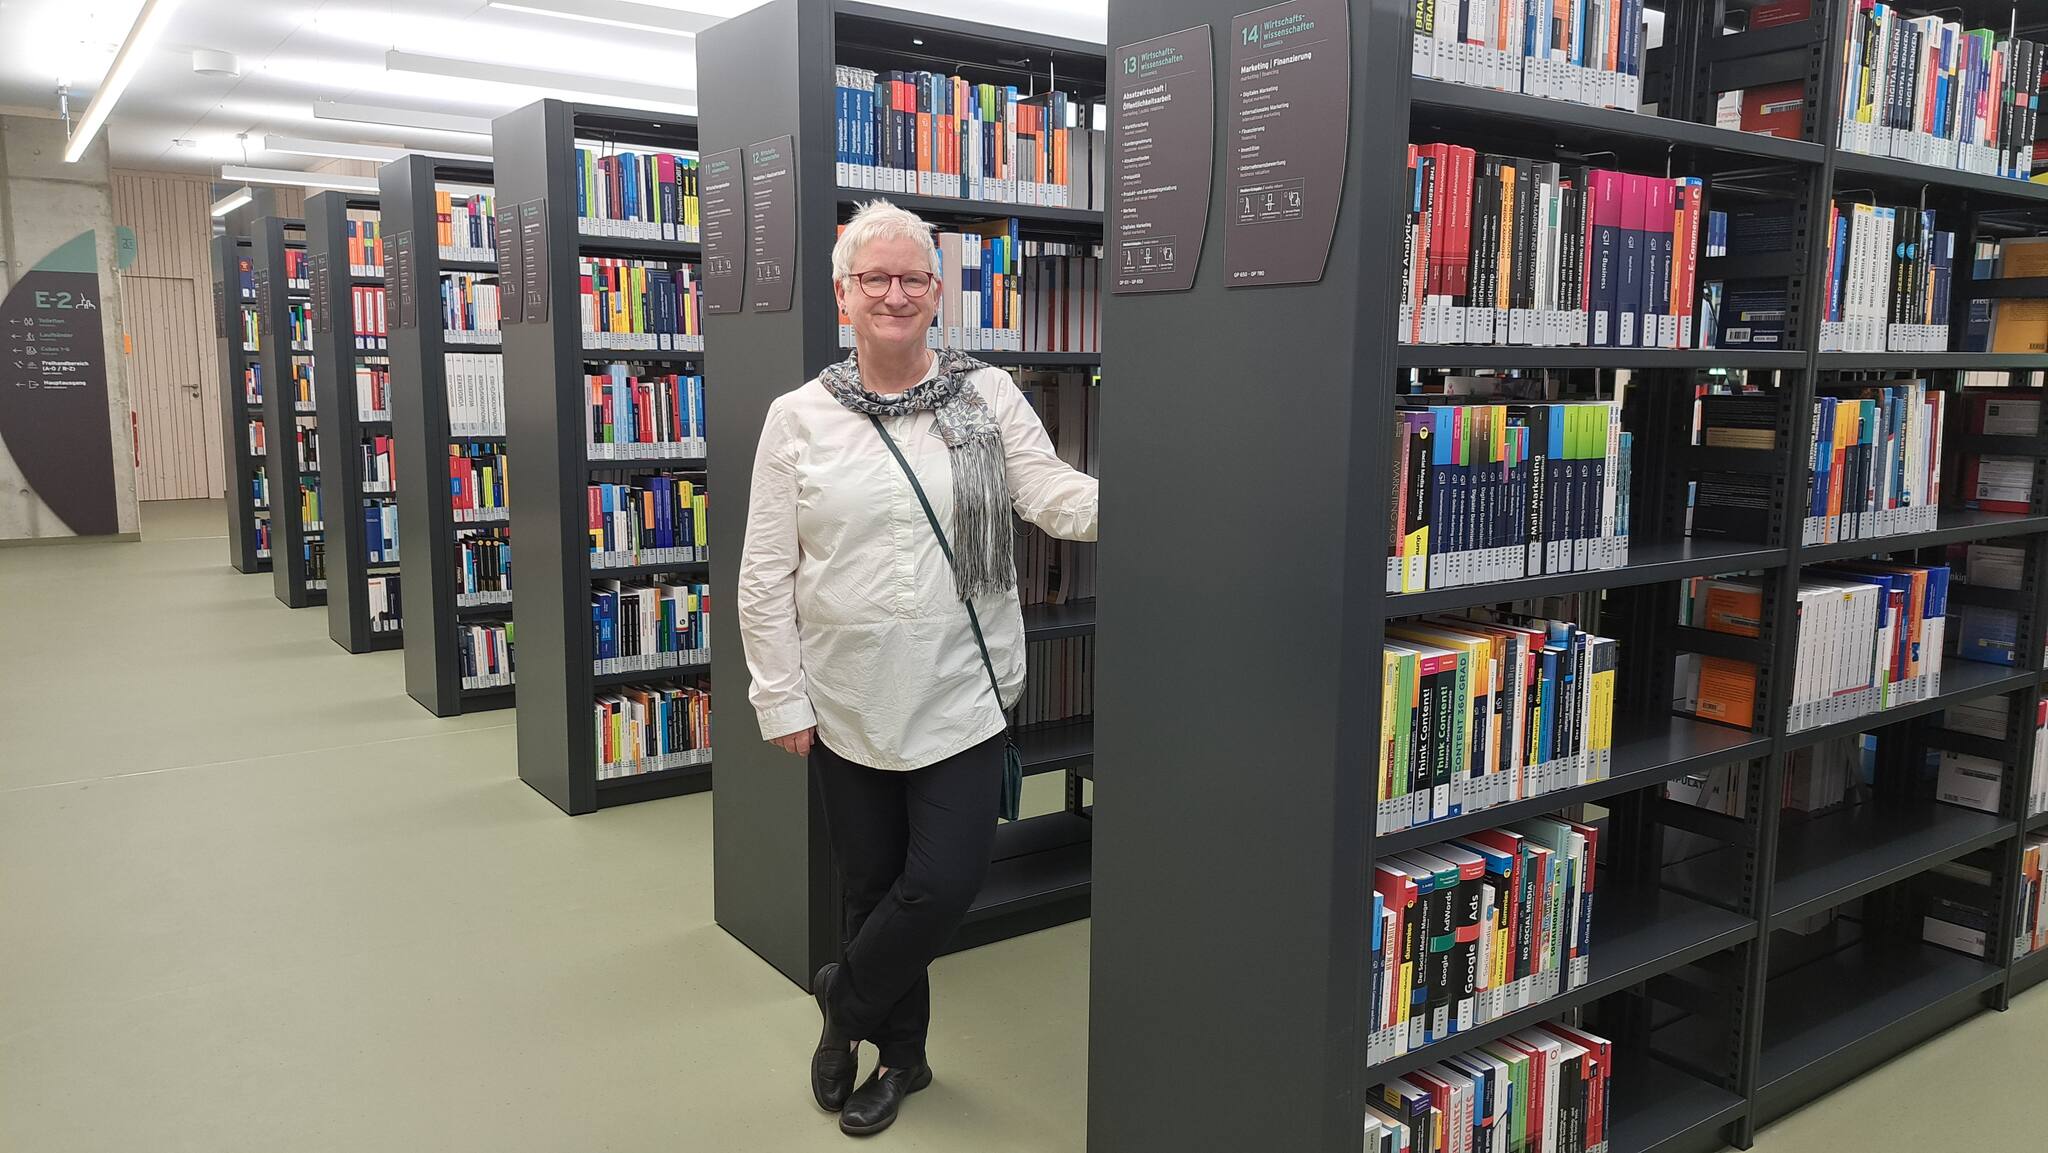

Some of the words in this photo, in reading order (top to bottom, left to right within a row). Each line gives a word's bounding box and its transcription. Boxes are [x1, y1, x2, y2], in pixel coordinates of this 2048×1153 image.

[1241, 24, 1259, 46] 14
[1263, 14, 1305, 30] Wirtschafts-
[1263, 21, 1315, 41] wissenschaften
[1124, 56, 1137, 74] 13
[1141, 47, 1176, 62] Wirtschafts-
[1141, 54, 1183, 70] wissenschaften
[1240, 62, 1269, 75] Marketing
[1273, 52, 1312, 67] Finanzierung
[1888, 67, 1896, 104] DIGITAL
[1892, 28, 1901, 66] DENKEN
[1897, 69, 1905, 106] DIGITAL
[1901, 31, 1909, 67] DENKEN
[1905, 71, 1913, 107] DIGITAL
[1909, 32, 1918, 69] DENKEN
[1404, 213, 1412, 263] Analytics
[1531, 204, 1539, 250] MARKETING
[1687, 209, 1698, 271] E-Commerce
[1401, 264, 1409, 306] oogle
[1600, 250, 1608, 290] E-Business
[35, 291, 73, 308] E-2
[1390, 460, 1401, 521] MARKETING
[1416, 488, 1425, 521] Marketing
[1530, 455, 1541, 543] E-Mail-Marketing
[1508, 664, 1516, 698] digital
[1420, 688, 1431, 743] Content!
[1439, 686, 1448, 740] Content!
[1455, 718, 1463, 772] CONTENT
[1459, 657, 1467, 689] GRAD
[1418, 746, 1427, 779] Think
[1436, 744, 1445, 776] Think
[1420, 900, 1428, 929] Manager
[1444, 891, 1452, 932] AdWords
[1469, 894, 1479, 921] Ads
[1550, 897, 1560, 957] SOCIALNOMICS
[1386, 922, 1395, 955] GUERRILLA
[1404, 922, 1413, 960] dummies
[1523, 946, 1529, 960] NO
[1440, 954, 1449, 986] Google
[1465, 944, 1476, 994] Google
